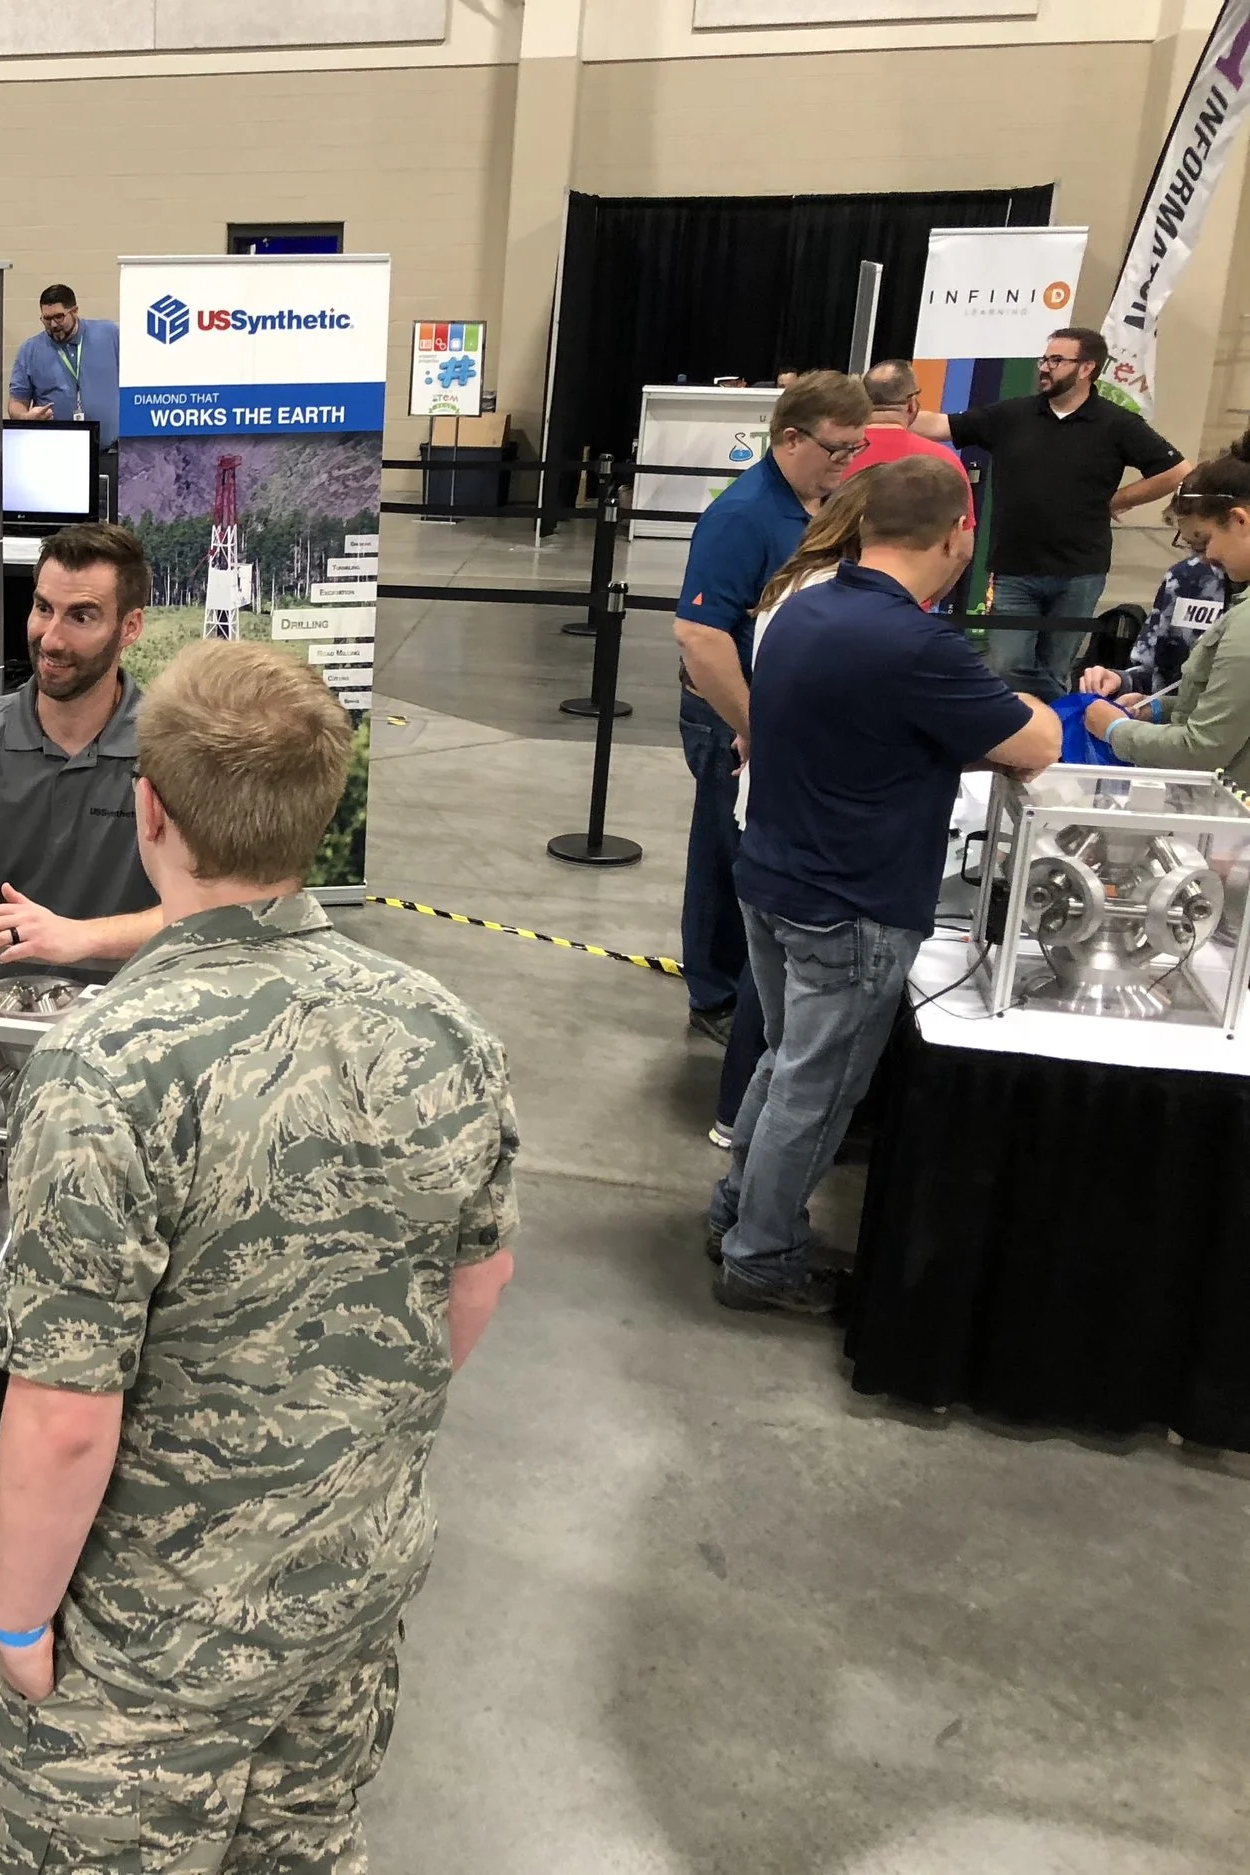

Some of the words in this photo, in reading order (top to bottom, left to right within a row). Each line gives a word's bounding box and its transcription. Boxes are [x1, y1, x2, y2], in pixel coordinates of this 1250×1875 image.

[197, 307, 352, 335] USSynthetic
[134, 393, 187, 405] DIAMOND
[190, 393, 220, 404] THAT
[150, 408, 227, 427] WORKS
[232, 407, 272, 425] THE
[278, 405, 345, 425] EARTH
